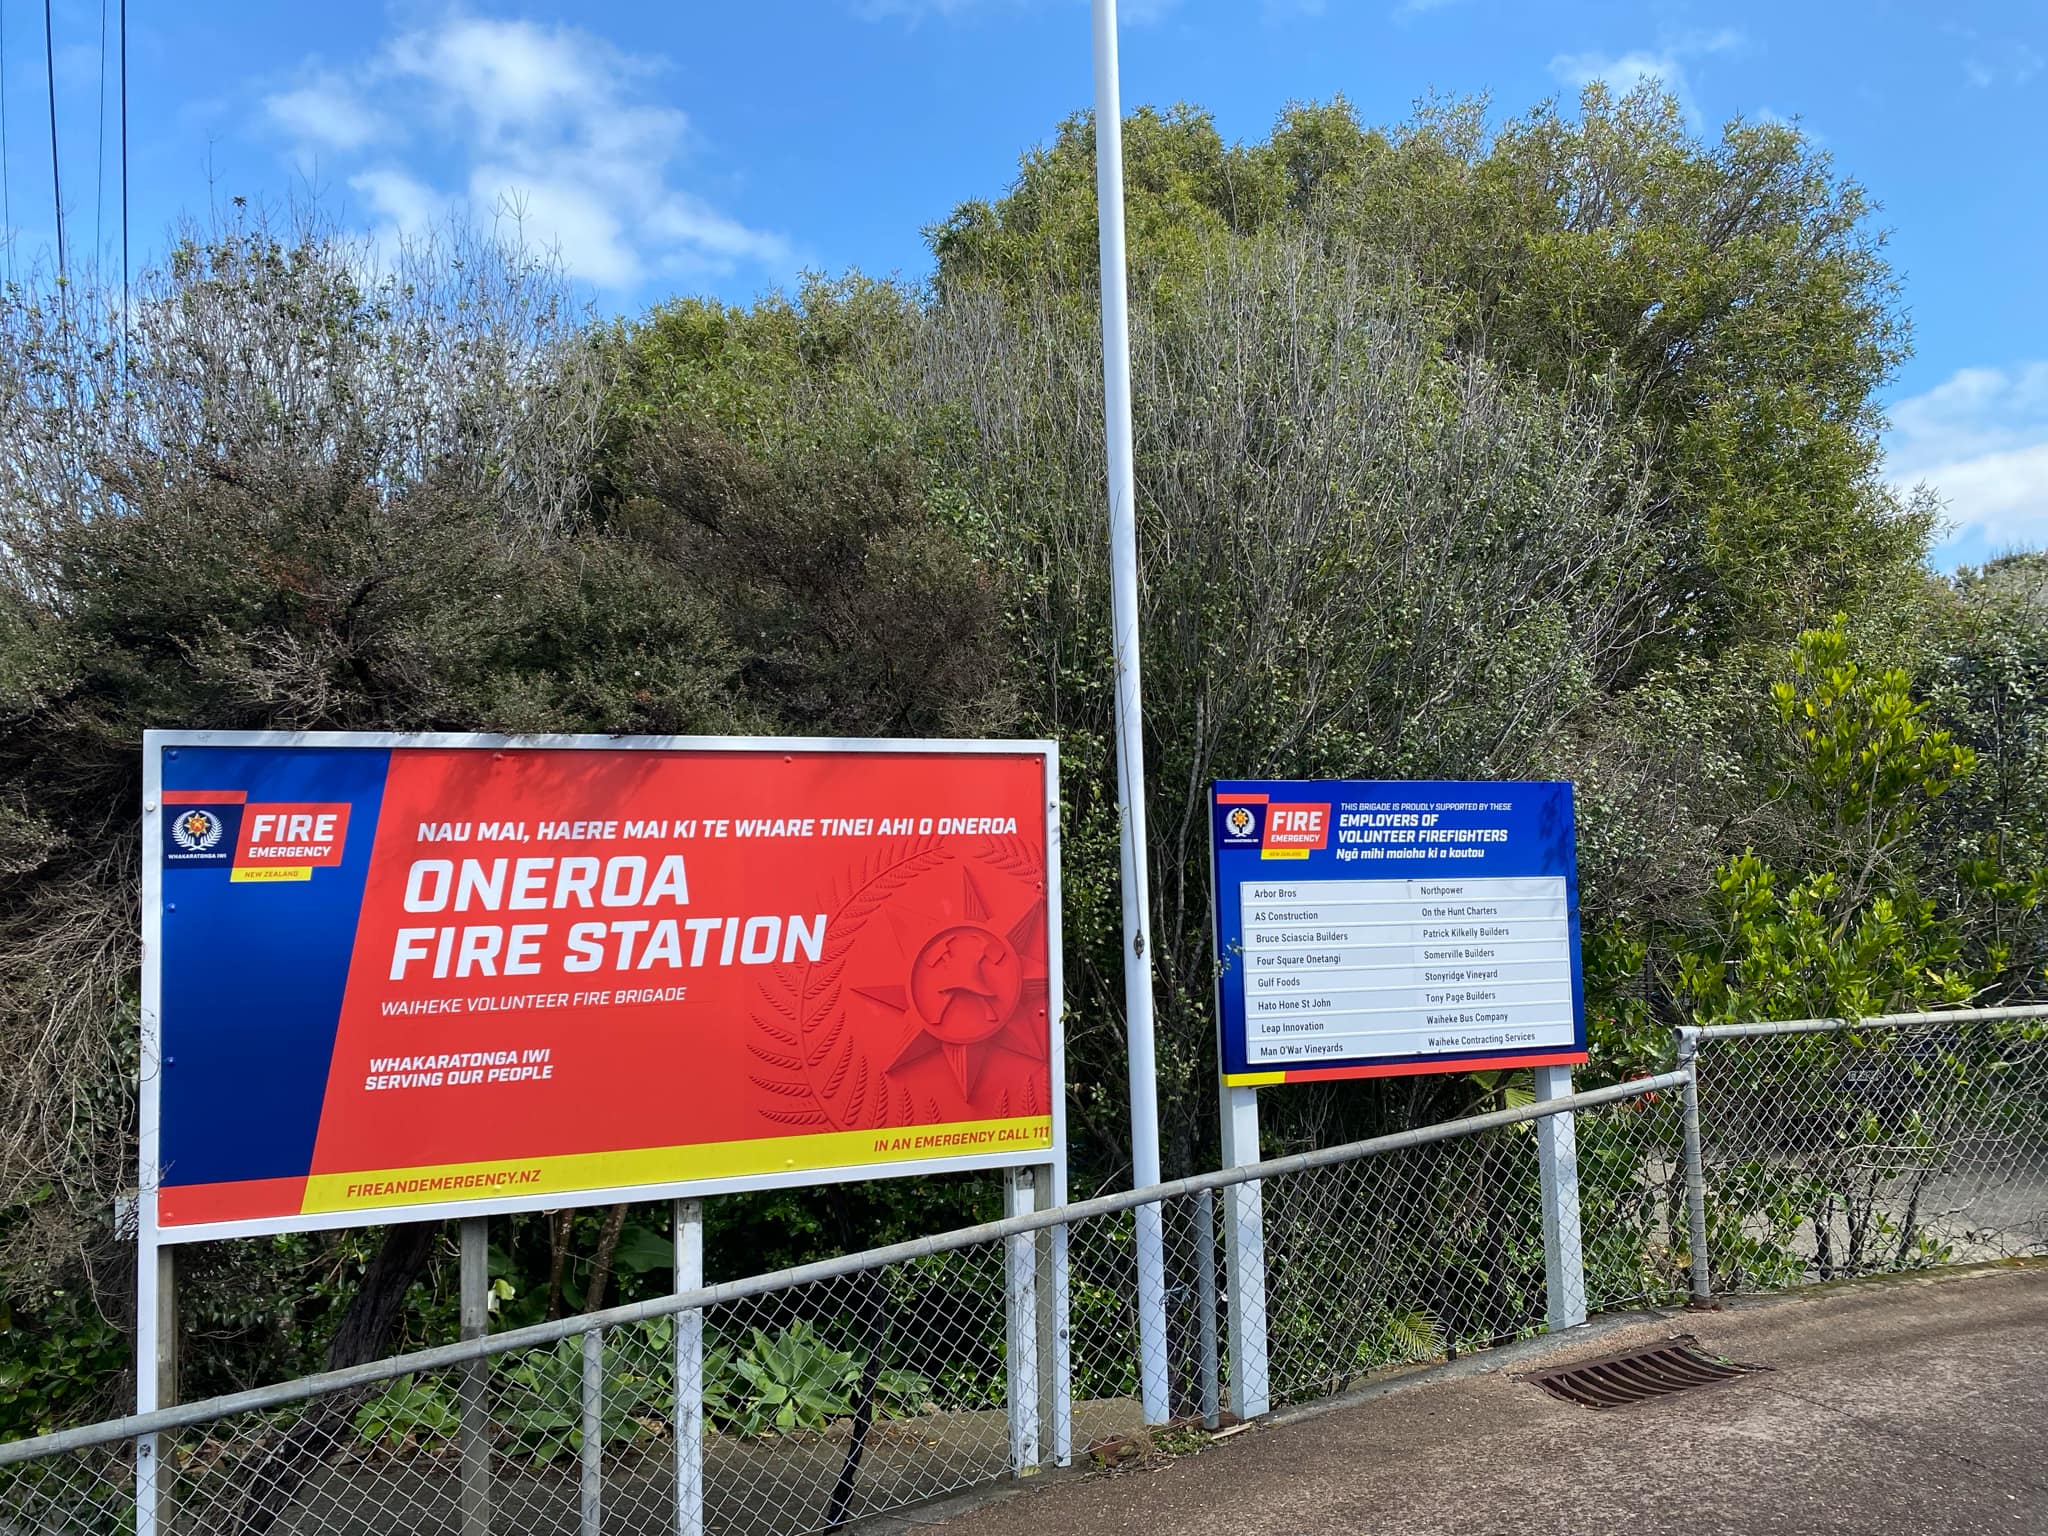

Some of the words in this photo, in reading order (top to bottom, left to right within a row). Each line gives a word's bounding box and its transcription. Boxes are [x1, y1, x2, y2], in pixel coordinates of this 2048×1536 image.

[1272, 811, 1323, 831] FIRE
[1339, 814, 1418, 827] EMPLOYERS
[1421, 814, 1439, 826] OF
[251, 814, 337, 842] FIRE
[417, 822, 470, 842] NAU
[477, 822, 531, 844] MAI,
[537, 821, 617, 840] HAERE
[623, 820, 667, 839] MAI
[673, 820, 697, 838] KI
[702, 820, 729, 838] TE
[735, 819, 815, 837] WHARE
[820, 818, 874, 836] TINEI
[877, 818, 913, 835] AHI
[919, 818, 932, 835] O
[938, 817, 1017, 835] ONEROA
[1271, 834, 1320, 842] EMERGENCY
[1338, 830, 1415, 843] VOLUNTEER
[1418, 830, 1508, 842] FIREFIGHTERS
[248, 846, 331, 858] EMERGENCY
[1361, 848, 1384, 859] mihi
[1387, 848, 1425, 859] maioha
[1428, 848, 1437, 858] ki
[1440, 850, 1446, 858] a
[1449, 848, 1484, 858] koutou
[403, 855, 689, 913] ONEROA
[1254, 889, 1276, 898] Arbor
[1279, 889, 1296, 897] Bros
[1420, 886, 1463, 896] Northpower
[1255, 912, 1265, 921] AS
[1268, 911, 1318, 920] Construction
[1422, 908, 1432, 917] On
[1434, 908, 1445, 916] the
[1466, 907, 1497, 915] Charters
[1256, 934, 1279, 943] Bruce
[1281, 933, 1313, 942] Sciascia
[1316, 932, 1348, 941] Builders
[1423, 929, 1449, 938] Patrick
[1451, 928, 1477, 938] Kilkelly
[1480, 927, 1509, 936] Builders
[389, 924, 548, 981] FIRE
[563, 914, 827, 973] STATION
[1256, 956, 1274, 965] Four
[1277, 956, 1304, 966] Square
[1306, 954, 1341, 964] Onetangi
[1424, 950, 1463, 959] Somerville
[1465, 949, 1494, 958] Builders
[1258, 978, 1274, 987] Gulf
[1277, 977, 1300, 986] Foods
[1425, 972, 1464, 982] Stonyridge
[1466, 970, 1498, 980] Vineyard
[381, 999, 463, 1016] WAIHEKE
[467, 993, 568, 1012] VOLUNTEER
[573, 991, 611, 1006] FIRE
[614, 987, 687, 1004] BRIGADE
[1426, 994, 1443, 1004] Tony
[1446, 993, 1464, 1002] Page
[1466, 992, 1496, 1000] Builders
[1258, 1002, 1276, 1010] Hato
[1279, 1001, 1299, 1009] Hone
[1301, 1000, 1310, 1008] St
[1312, 999, 1331, 1007] John
[1426, 1015, 1457, 1024] Waiheke
[1475, 1013, 1508, 1023] Company
[1262, 1024, 1280, 1034] Leap
[1283, 1021, 1324, 1032] Innovation
[1428, 1036, 1459, 1046] Waiheke
[1461, 1035, 1503, 1044] Contracting
[1505, 1033, 1535, 1041] Services
[1261, 1047, 1277, 1056] Man
[1280, 1046, 1302, 1055] O'War
[1304, 1043, 1343, 1054] Vineyards
[369, 1050, 518, 1073] WHAKARATONGA
[522, 1049, 550, 1063] IWI
[365, 1072, 443, 1090] SERVING
[447, 1070, 484, 1085] OUR
[487, 1066, 553, 1082] PEOPLE
[874, 1140, 888, 1152] IN
[892, 1138, 911, 1150] AN
[915, 1131, 996, 1148] EMERGENCY
[998, 1128, 1029, 1141] CALL
[1033, 1126, 1049, 1138] 111
[347, 1170, 541, 1197] FIREANDEMERGENCY.NZ
